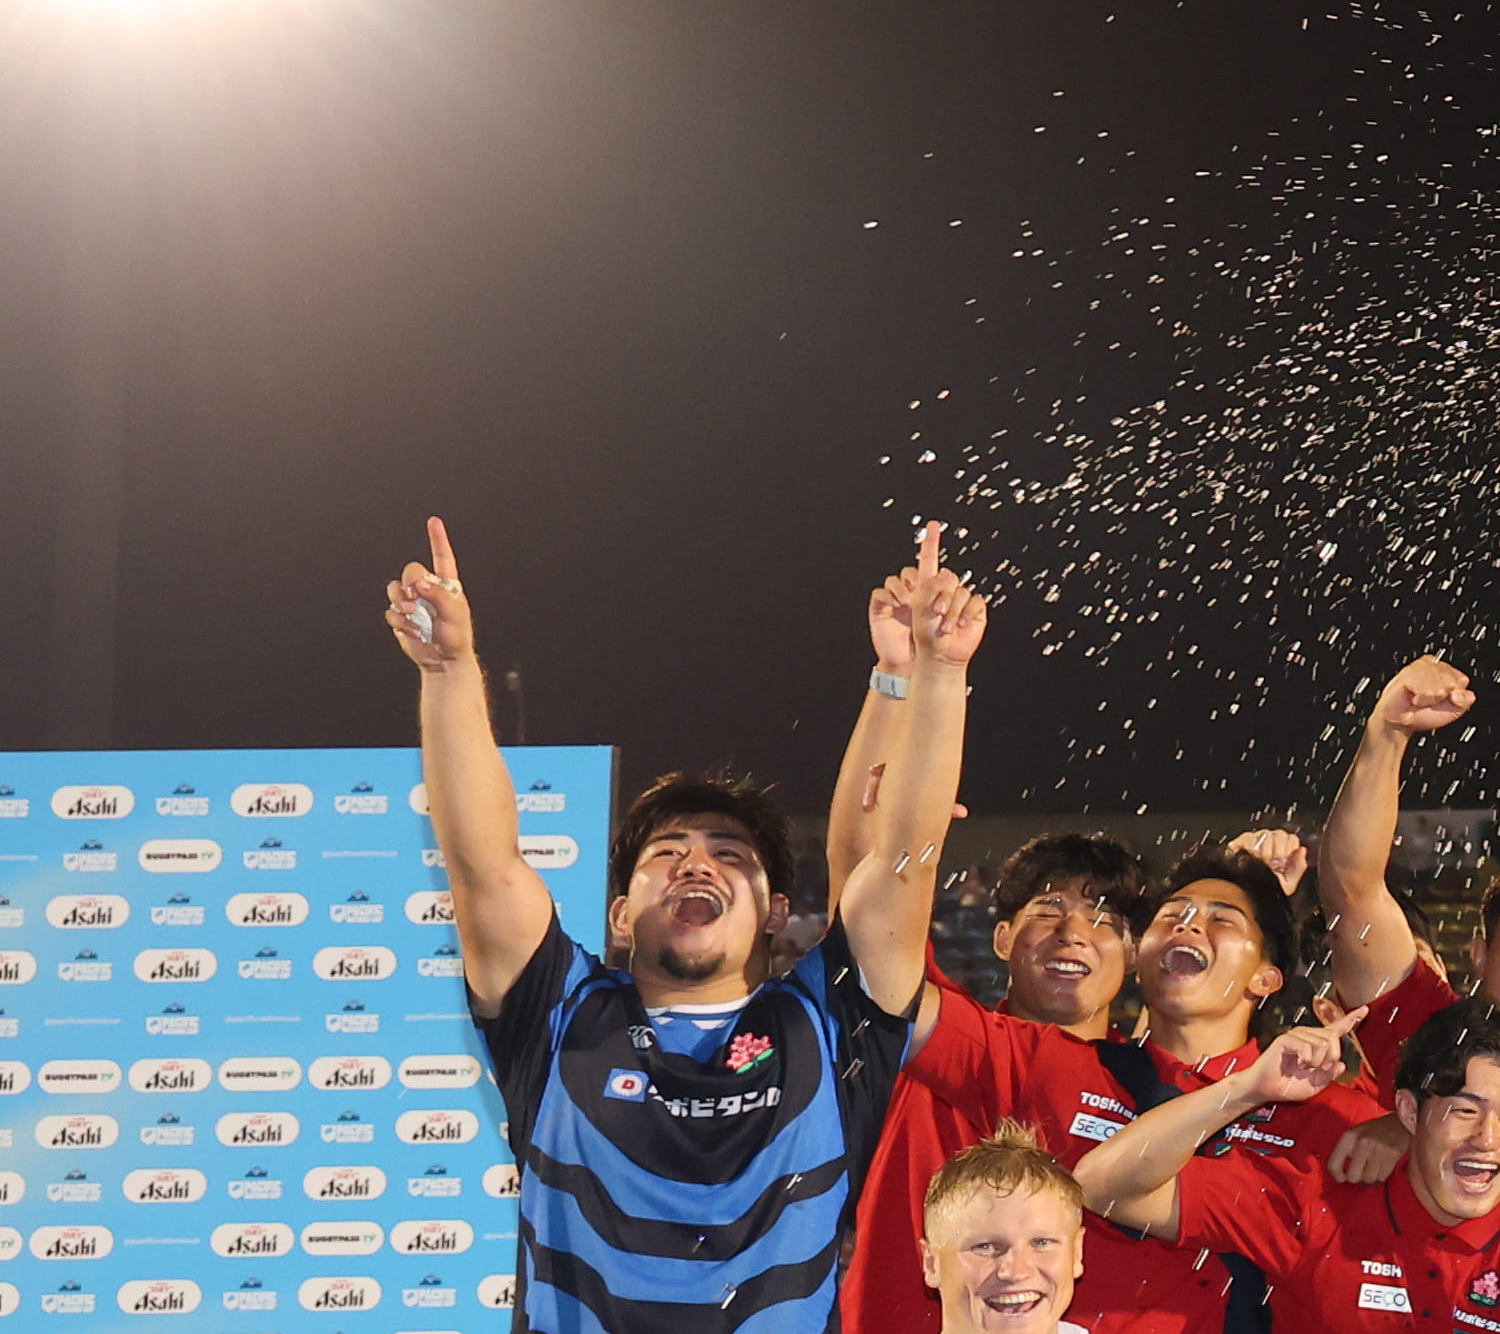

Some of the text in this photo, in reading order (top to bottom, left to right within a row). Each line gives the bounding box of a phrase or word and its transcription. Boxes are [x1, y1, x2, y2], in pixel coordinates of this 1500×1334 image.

[68, 797, 117, 815] Asahi
[248, 796, 296, 813] Asahi
[63, 907, 112, 925] Asahi
[243, 905, 292, 923] Asahi
[151, 961, 200, 979] Asahi
[330, 959, 379, 976] Asahi
[146, 1070, 195, 1089] Asahi
[325, 1068, 374, 1086] Asahi
[52, 1127, 102, 1145] Asahi
[233, 1125, 282, 1142] Asahi
[413, 1122, 461, 1140] Asahi
[1076, 1118, 1119, 1139] SECO
[140, 1181, 189, 1199] Asahi
[321, 1179, 369, 1196] Asahi
[46, 1237, 96, 1256] Asahi
[228, 1235, 277, 1253] Asahi
[408, 1232, 456, 1250] Asahi
[135, 1292, 184, 1310] Asahi
[316, 1290, 364, 1307] Asahi
[1363, 1289, 1406, 1307] SECO
